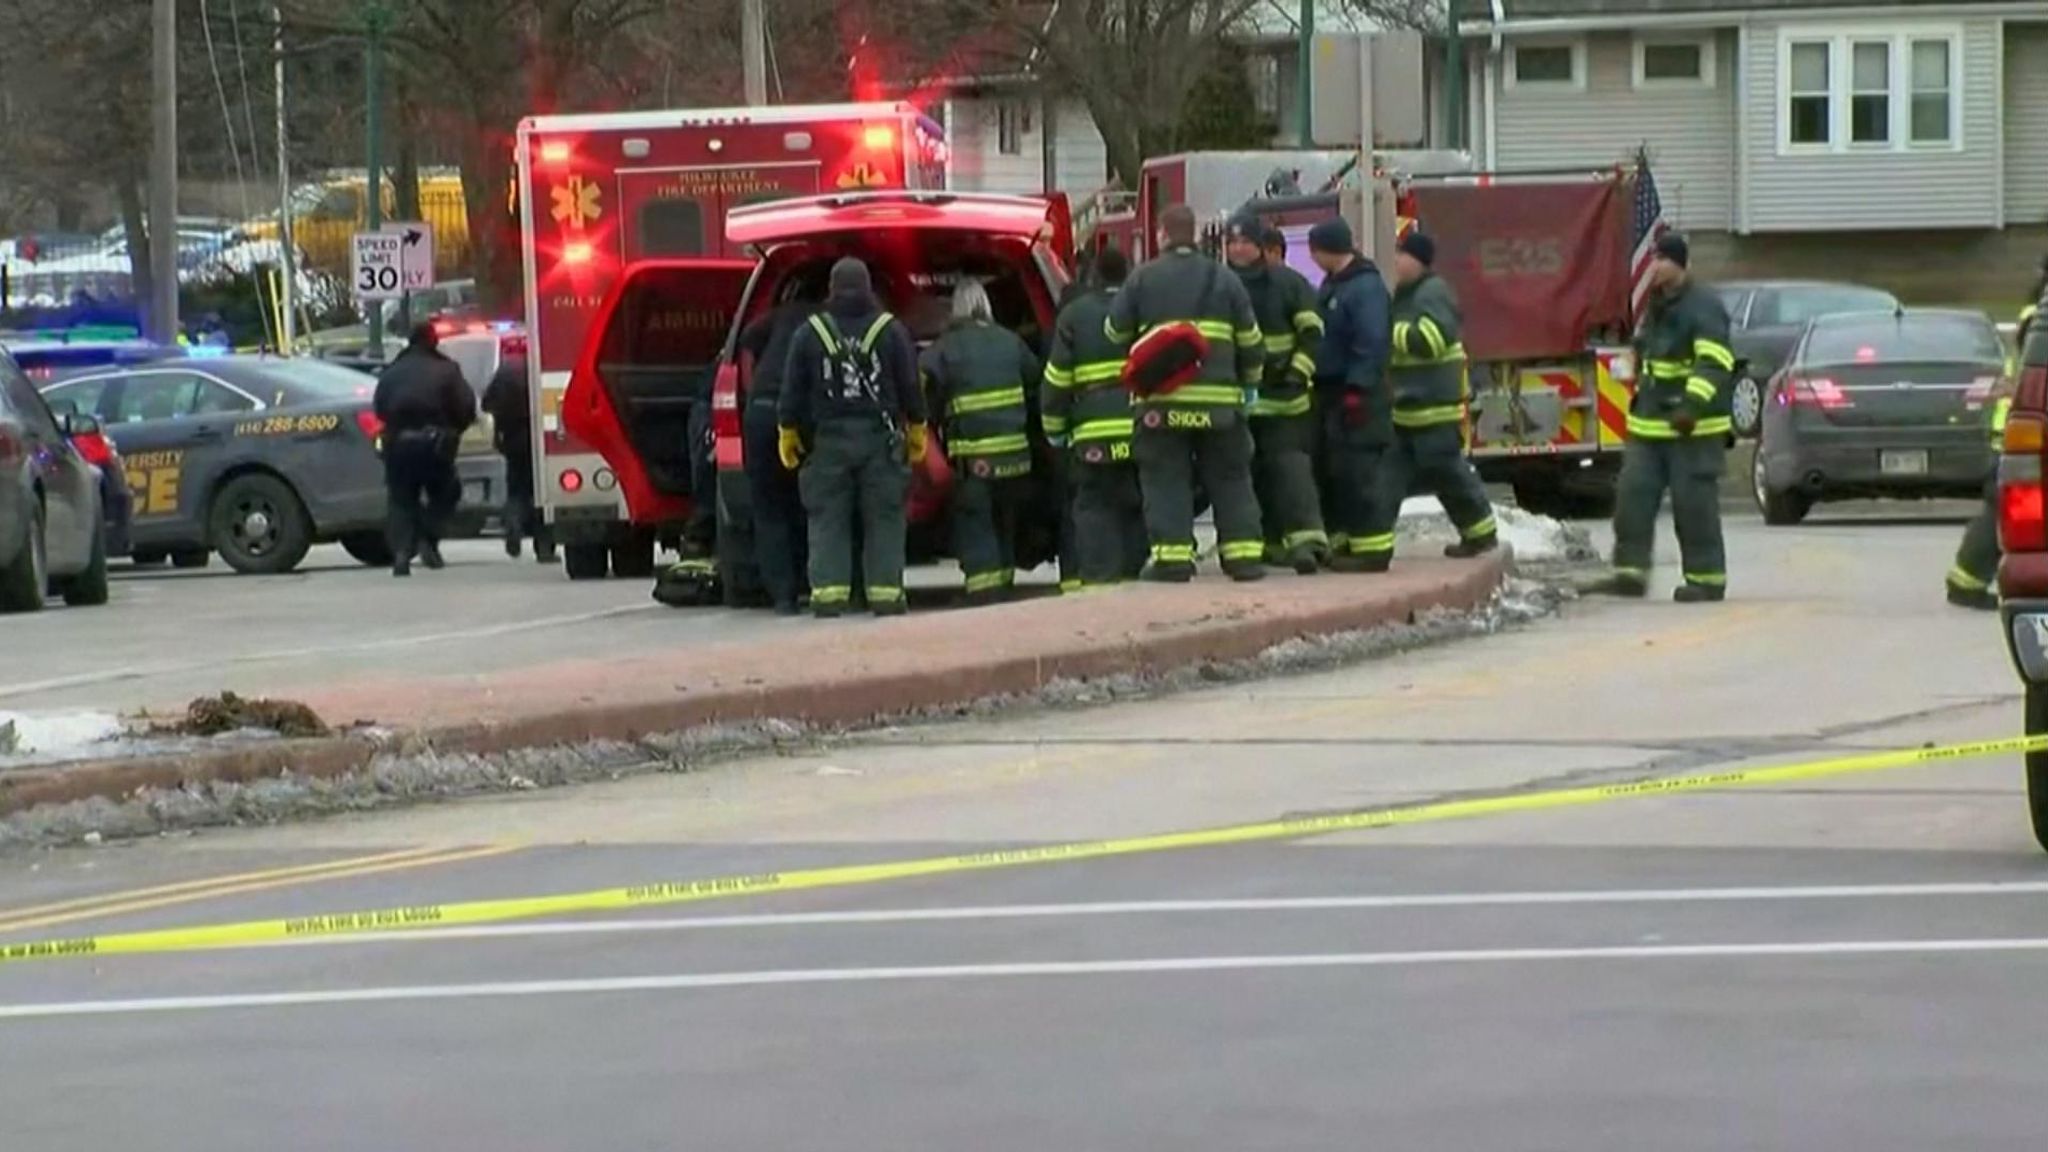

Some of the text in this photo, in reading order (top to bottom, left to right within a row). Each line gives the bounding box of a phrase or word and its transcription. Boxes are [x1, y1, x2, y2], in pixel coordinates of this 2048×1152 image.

[692, 181, 779, 196] DEPARTMENT
[357, 239, 398, 251] SPEED
[361, 253, 392, 264] LIMIT
[359, 266, 398, 291] 30
[262, 414, 338, 432] 288-6800
[1168, 411, 1211, 428] SHOCK
[121, 450, 184, 469] VERSITY
[1110, 442, 1130, 460] HO
